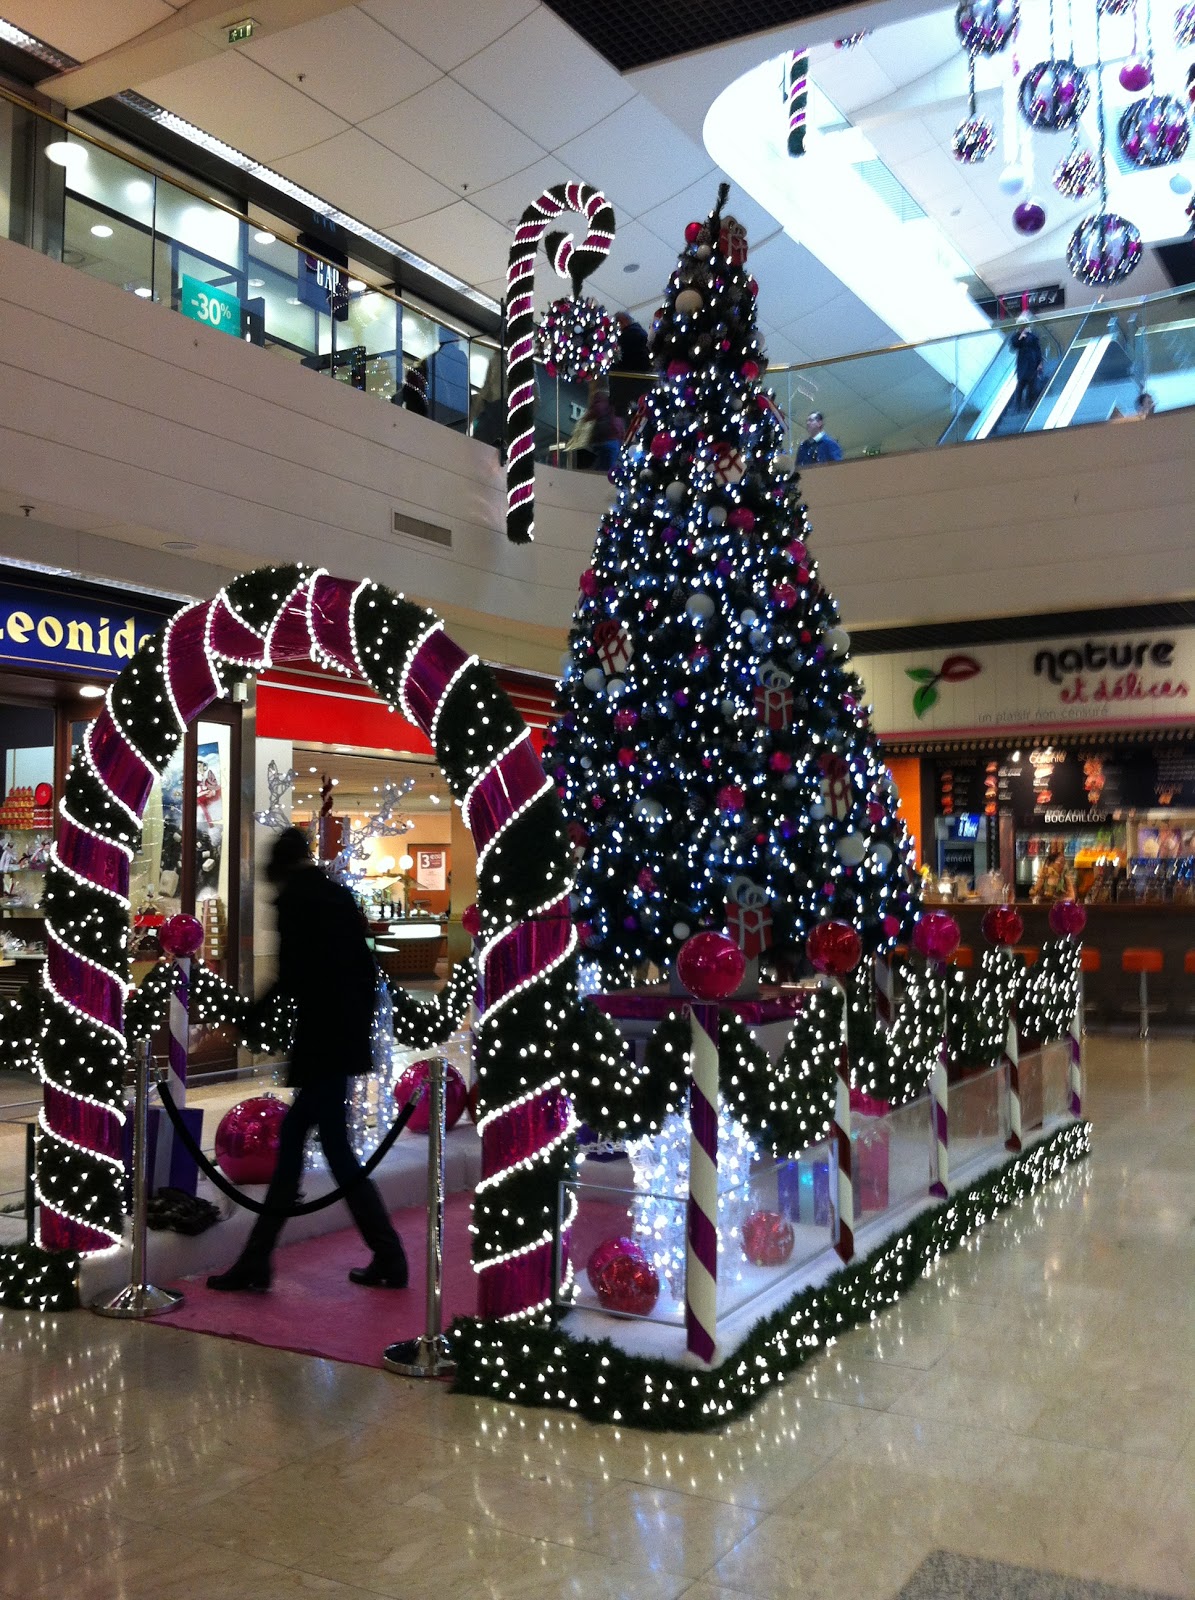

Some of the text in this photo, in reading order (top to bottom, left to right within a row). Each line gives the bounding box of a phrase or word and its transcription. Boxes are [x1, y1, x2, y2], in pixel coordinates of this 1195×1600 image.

[316, 259, 340, 295] GAP
[190, 293, 232, 325] -30%
[0, 611, 151, 660] eonid
[1034, 638, 1176, 685] nature
[1060, 671, 1191, 704] et délices
[1036, 707, 1056, 720] non
[1044, 812, 1107, 823] BOCADILLOS
